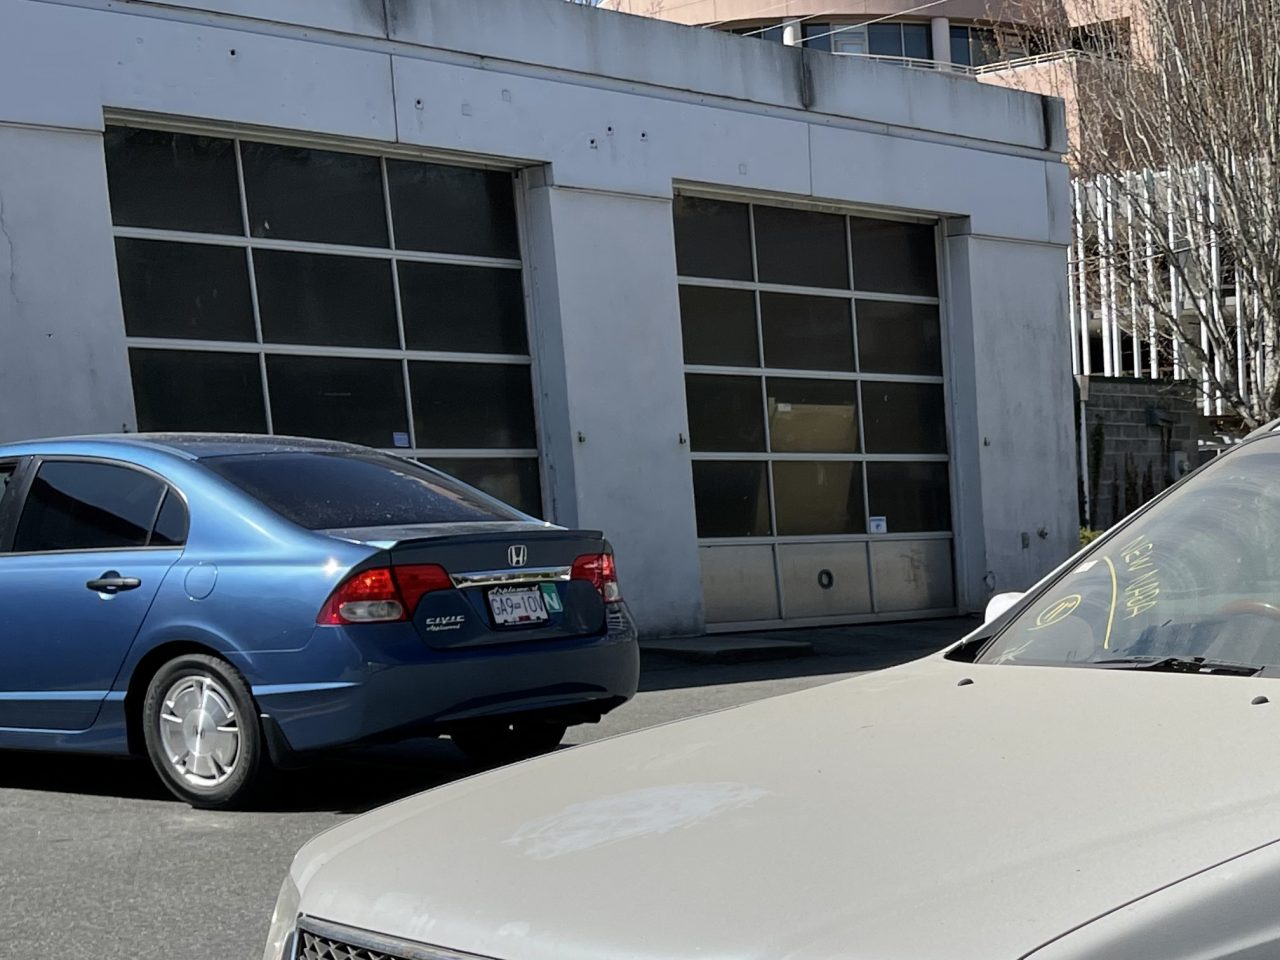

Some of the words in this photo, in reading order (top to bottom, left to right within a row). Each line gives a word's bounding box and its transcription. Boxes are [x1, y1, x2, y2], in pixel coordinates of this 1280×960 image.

[1120, 534, 1153, 572] NEW
[543, 592, 560, 610] N
[425, 614, 465, 625] CIVIC
